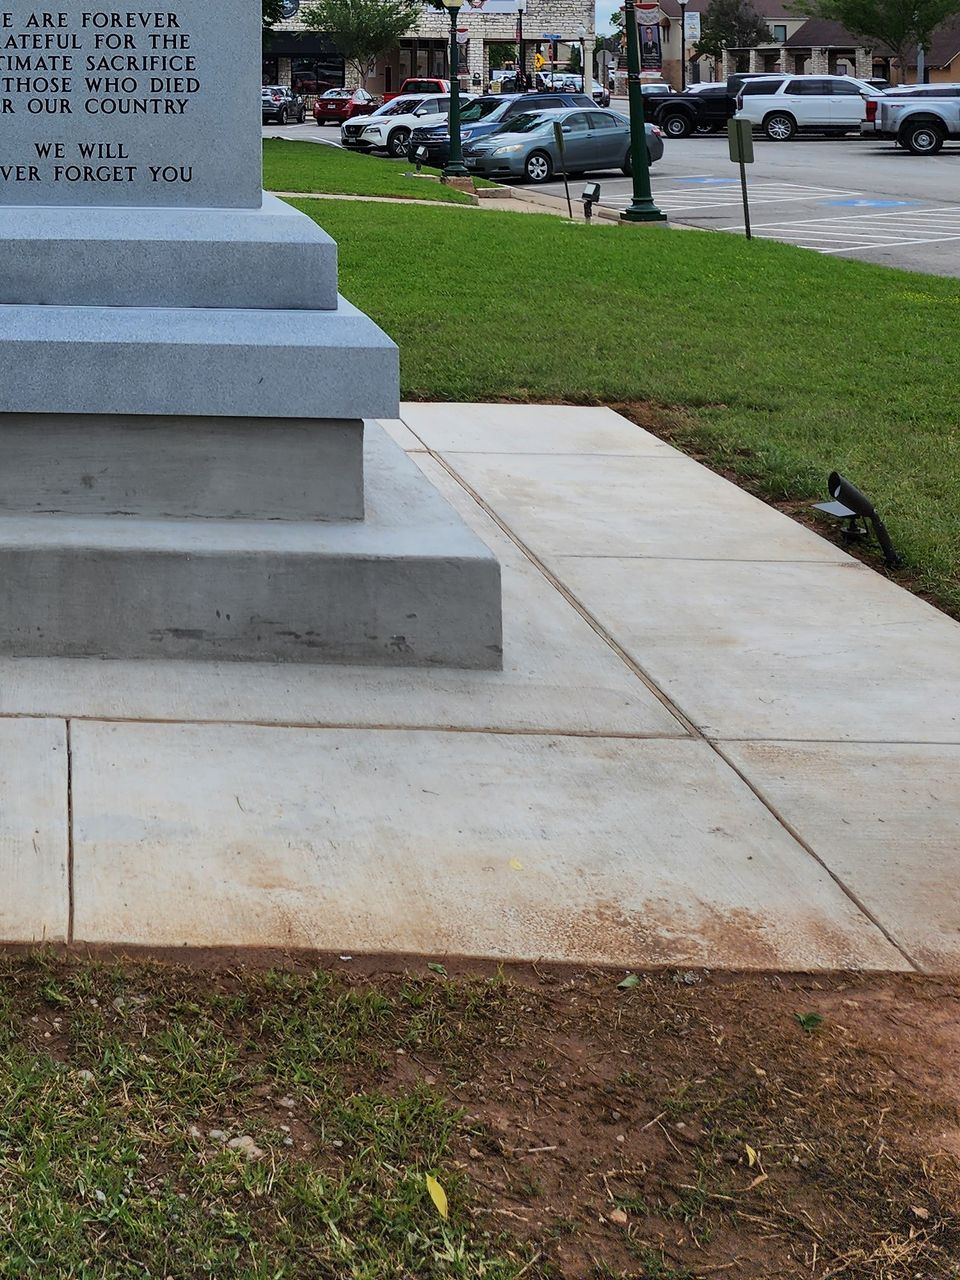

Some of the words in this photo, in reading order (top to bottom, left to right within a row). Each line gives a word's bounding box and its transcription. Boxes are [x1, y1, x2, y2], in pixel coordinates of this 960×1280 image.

[25, 12, 69, 29] ARE
[81, 12, 181, 29] FOREVER
[94, 33, 137, 50] FOR
[147, 33, 191, 50] THE
[85, 55, 197, 72] SACRIFICE
[1, 76, 73, 93] THOSE
[84, 76, 138, 94] WHO
[150, 77, 201, 94] DIED
[27, 98, 73, 115] OUR
[84, 97, 190, 117] COUNTRY
[34, 142, 66, 160] WE
[78, 142, 129, 160] WILL
[54, 166, 138, 183] FORGET
[149, 166, 193, 183] YOU
